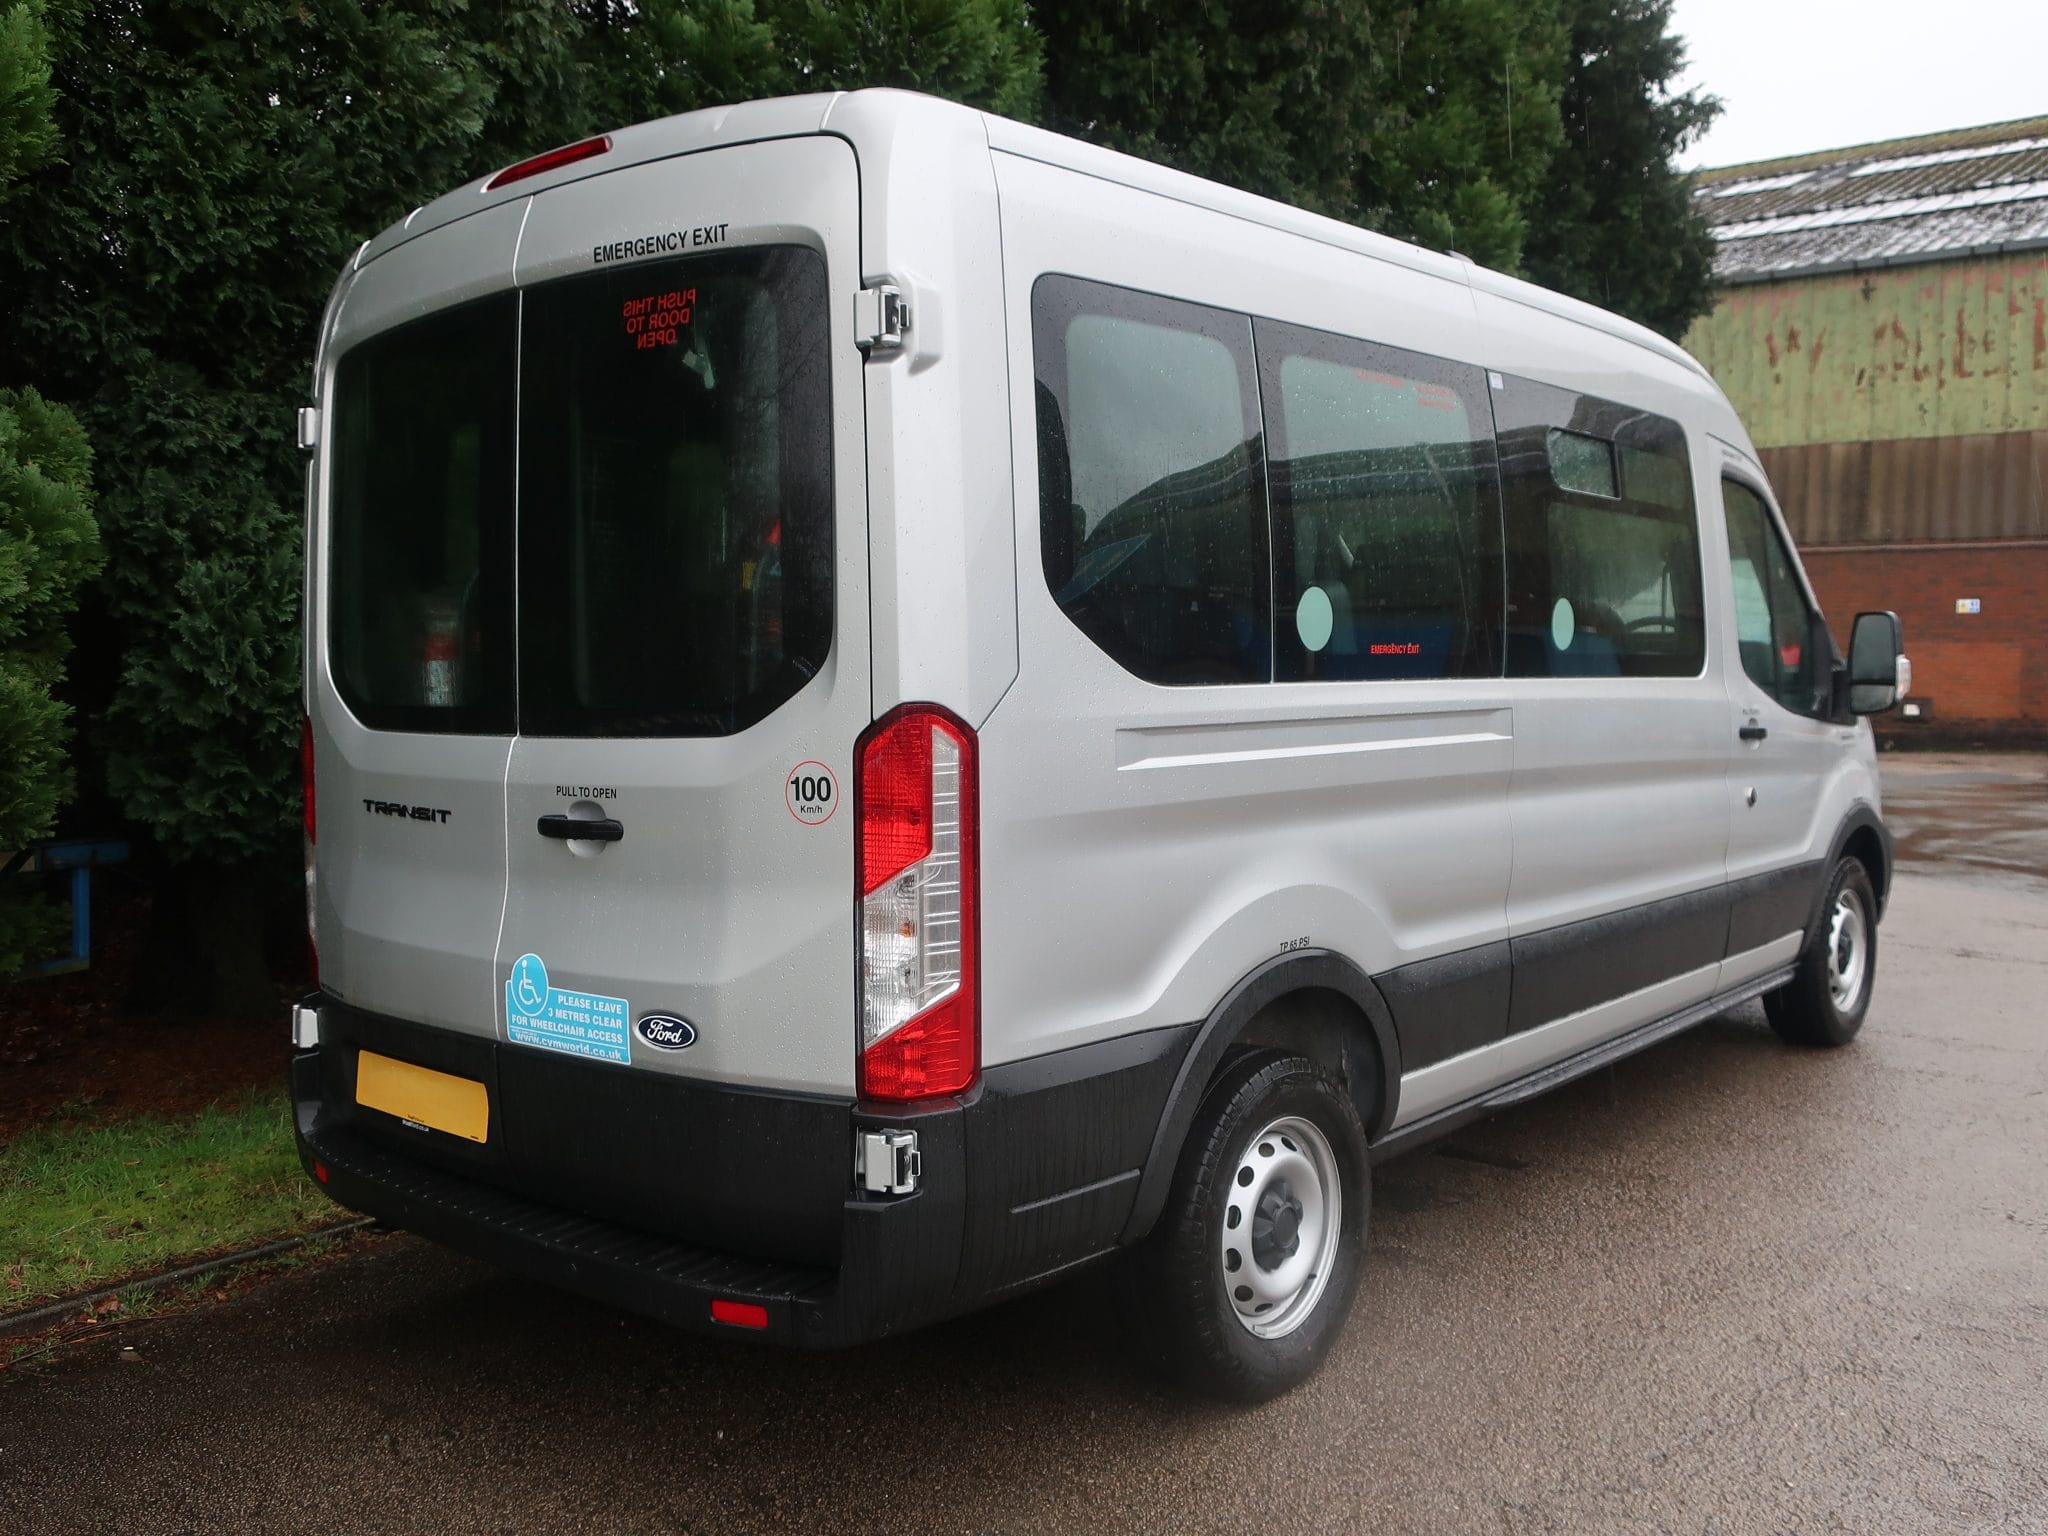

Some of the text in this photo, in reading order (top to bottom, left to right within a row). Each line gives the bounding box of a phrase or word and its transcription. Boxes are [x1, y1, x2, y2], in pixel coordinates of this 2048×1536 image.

[593, 223, 729, 263] EMERGENCY EXIT
[1370, 643, 1420, 654] EMERGENCY EXIT
[555, 785, 617, 799] PULL TO OPEN
[790, 776, 831, 802] 100
[363, 798, 452, 824] TRANSIT
[800, 804, 823, 814] Km/h
[1280, 941, 1289, 953] TP
[1299, 935, 1310, 948] PSI
[557, 995, 622, 1014] PLEASE LEAVE
[511, 1014, 528, 1026] FOR
[530, 1017, 585, 1037] WHEELCHAIR
[587, 1029, 623, 1044] ACCESS
[548, 1007, 623, 1029] 3 METRES CLEAR
[646, 1019, 682, 1043] Ford
